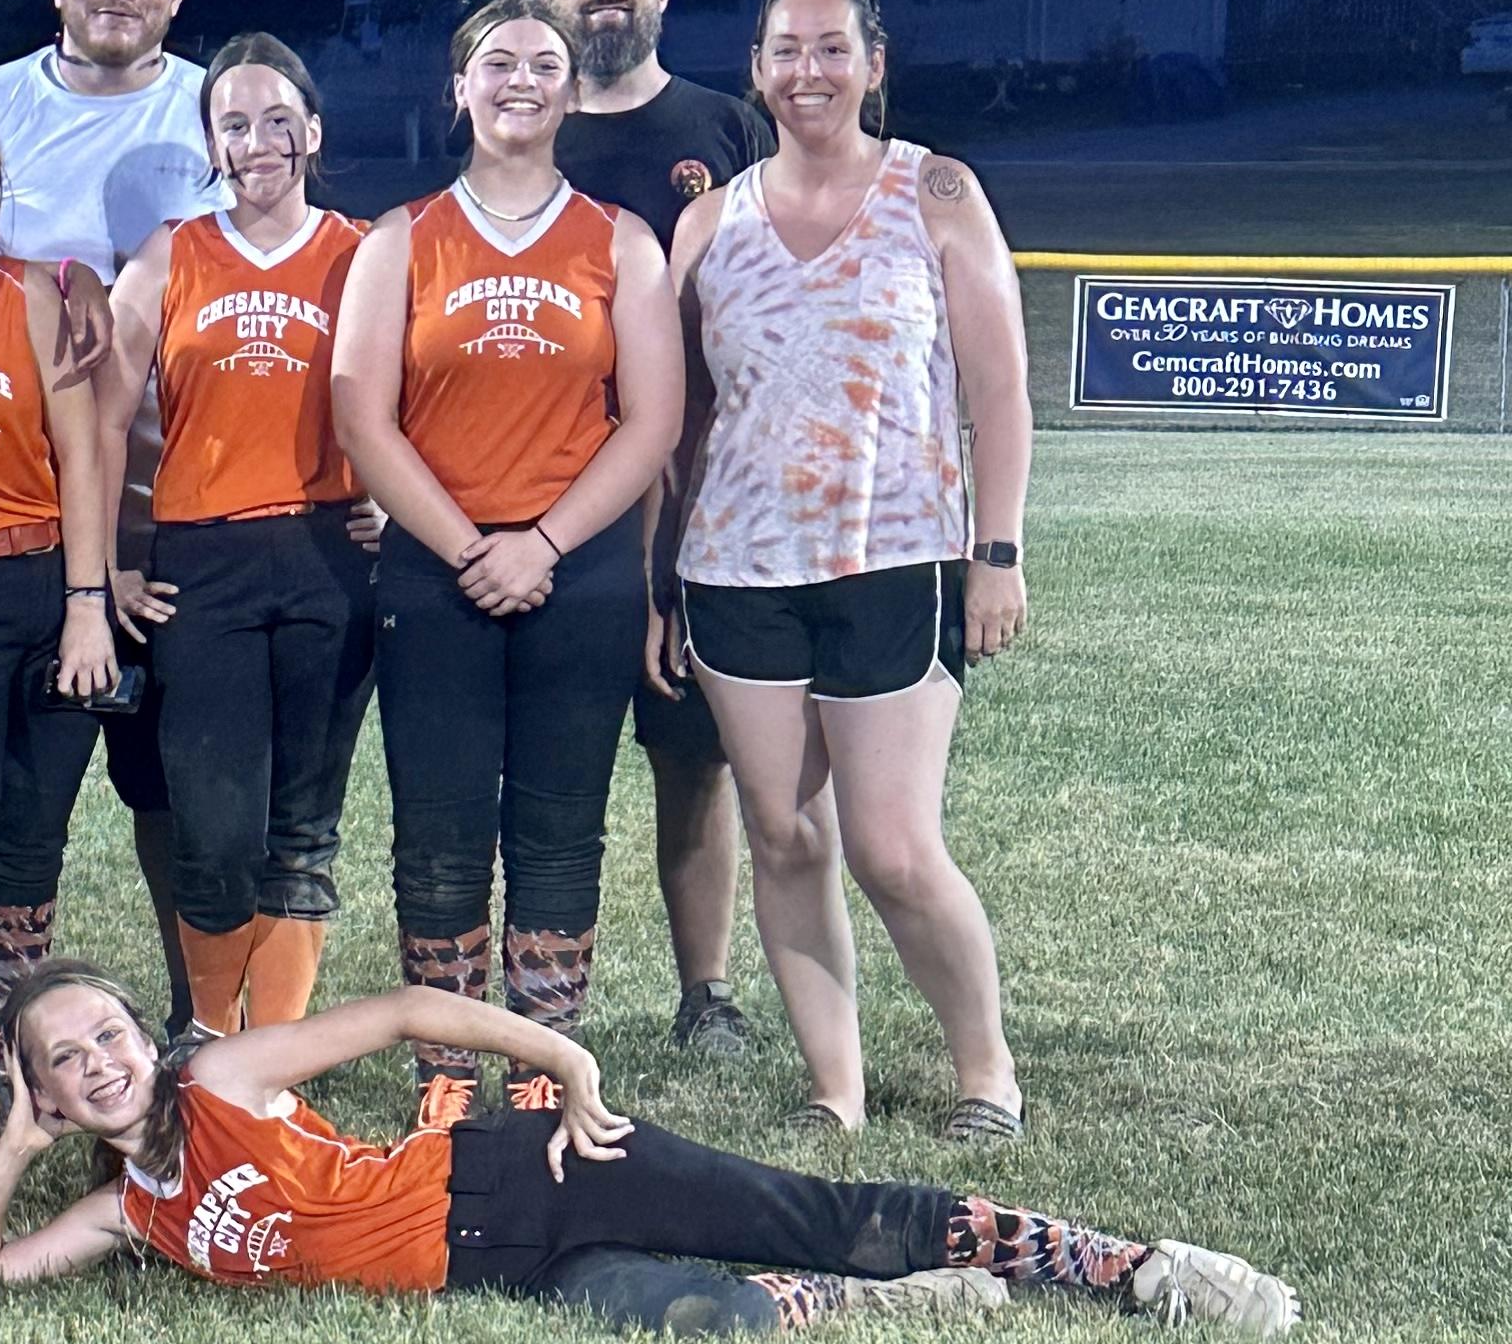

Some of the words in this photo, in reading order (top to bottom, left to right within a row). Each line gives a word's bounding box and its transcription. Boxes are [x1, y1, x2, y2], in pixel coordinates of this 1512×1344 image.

[195, 290, 330, 336] CHESAPEAKE
[444, 275, 583, 321] CHESAPEAKE
[486, 297, 541, 322] CITY
[1096, 292, 1265, 324] GEMCRAFT
[1313, 297, 1430, 331] HOMES
[236, 314, 288, 340] CITY
[1110, 328, 1151, 342] OVER
[1190, 329, 1239, 344] YEARS
[1242, 330, 1266, 344] OF
[1268, 331, 1343, 348] BUILDING
[1346, 334, 1412, 350] DREAMS
[1131, 350, 1382, 380] GemcraftHomes.com
[1171, 375, 1337, 401] 800-291-7436
[212, 1197, 252, 1255] CITY
